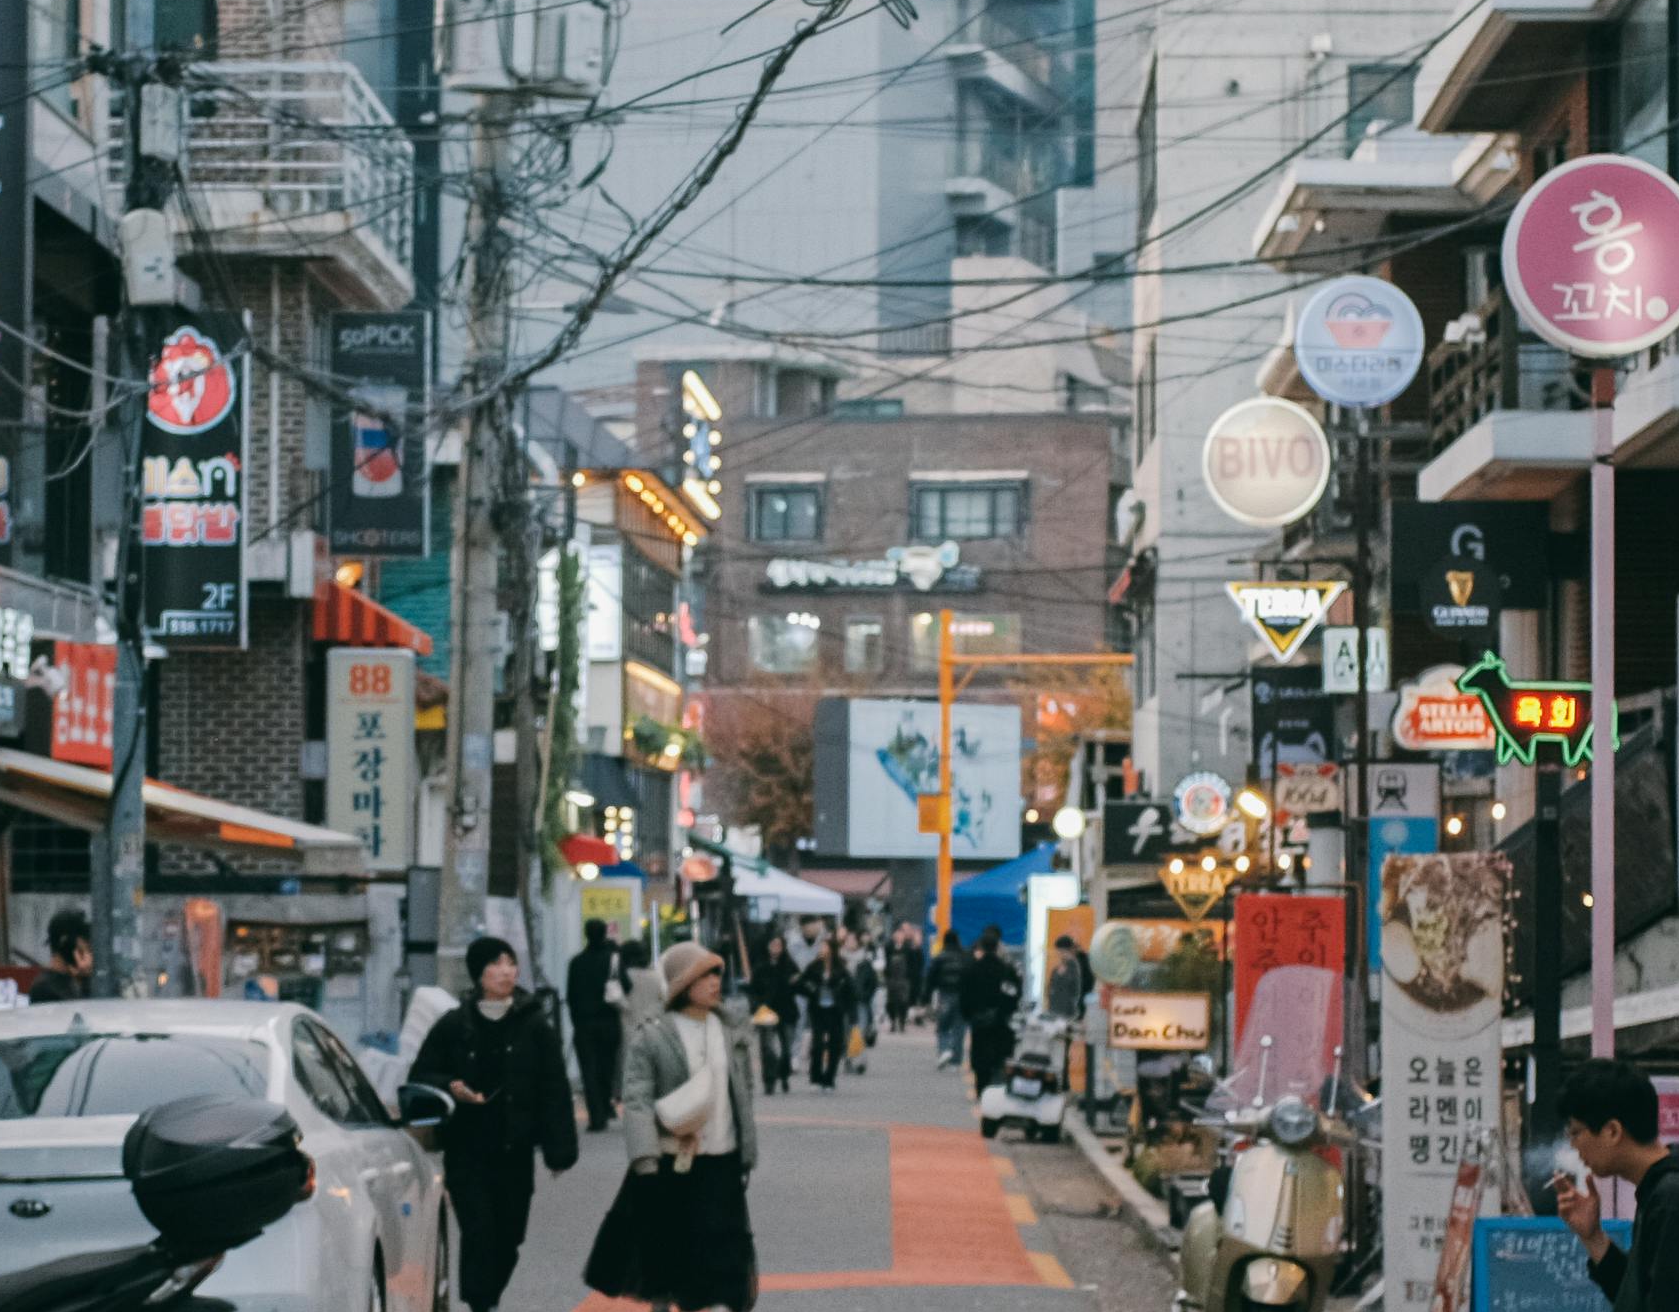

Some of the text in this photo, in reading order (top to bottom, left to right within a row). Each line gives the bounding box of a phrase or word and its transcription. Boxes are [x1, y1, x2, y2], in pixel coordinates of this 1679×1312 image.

[1553, 281, 1643, 322] 꼬치
[1215, 435, 1320, 480] BIVO
[201, 584, 236, 610] 2F
[1239, 587, 1322, 619] TERRA
[348, 663, 393, 695] 88
[1419, 703, 1485, 718] STELLA
[1419, 719, 1486, 733] ARTOIS
[352, 711, 388, 859] 포장마차
[1407, 1055, 1484, 1088] 오늘은
[1408, 1095, 1484, 1126] 라멘이
